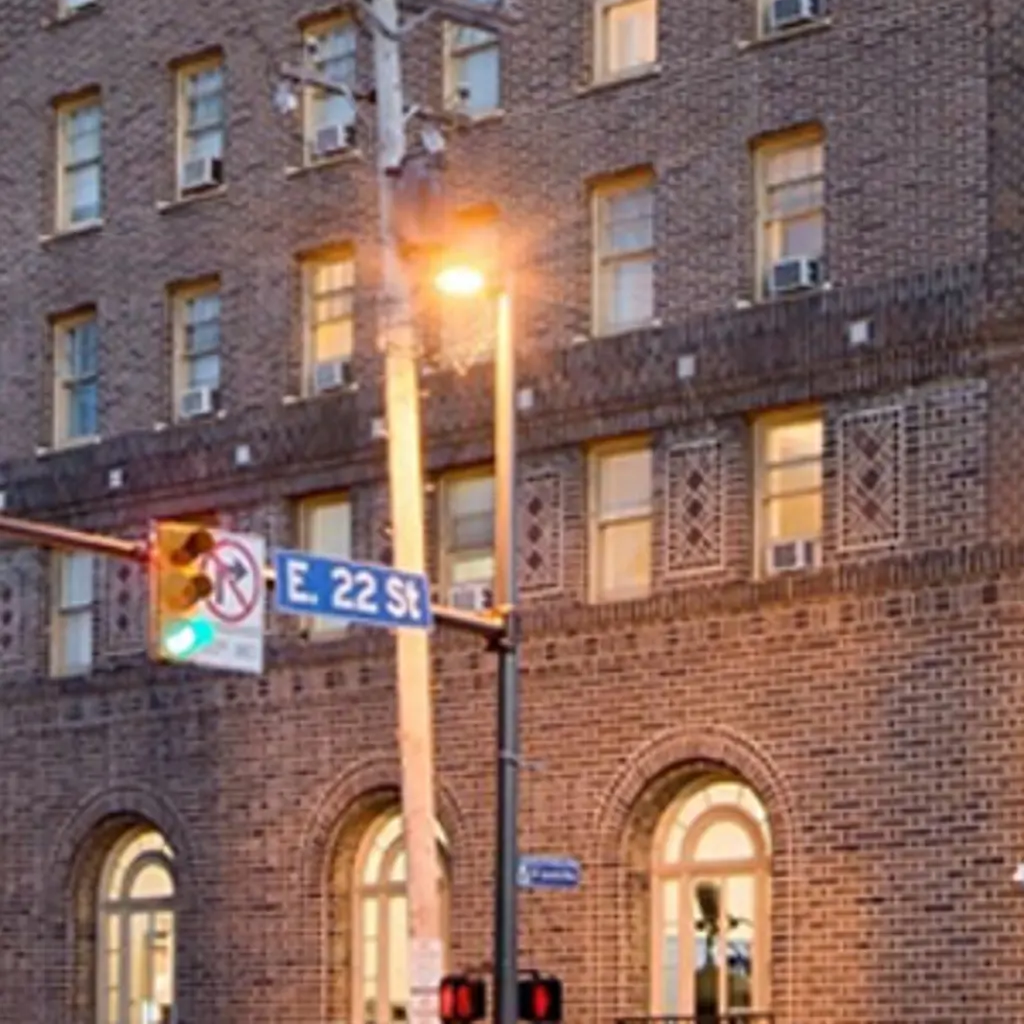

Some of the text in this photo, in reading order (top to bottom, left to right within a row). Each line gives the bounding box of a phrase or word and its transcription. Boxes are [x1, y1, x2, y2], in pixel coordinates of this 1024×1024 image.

[286, 557, 421, 619] E. 22 St
